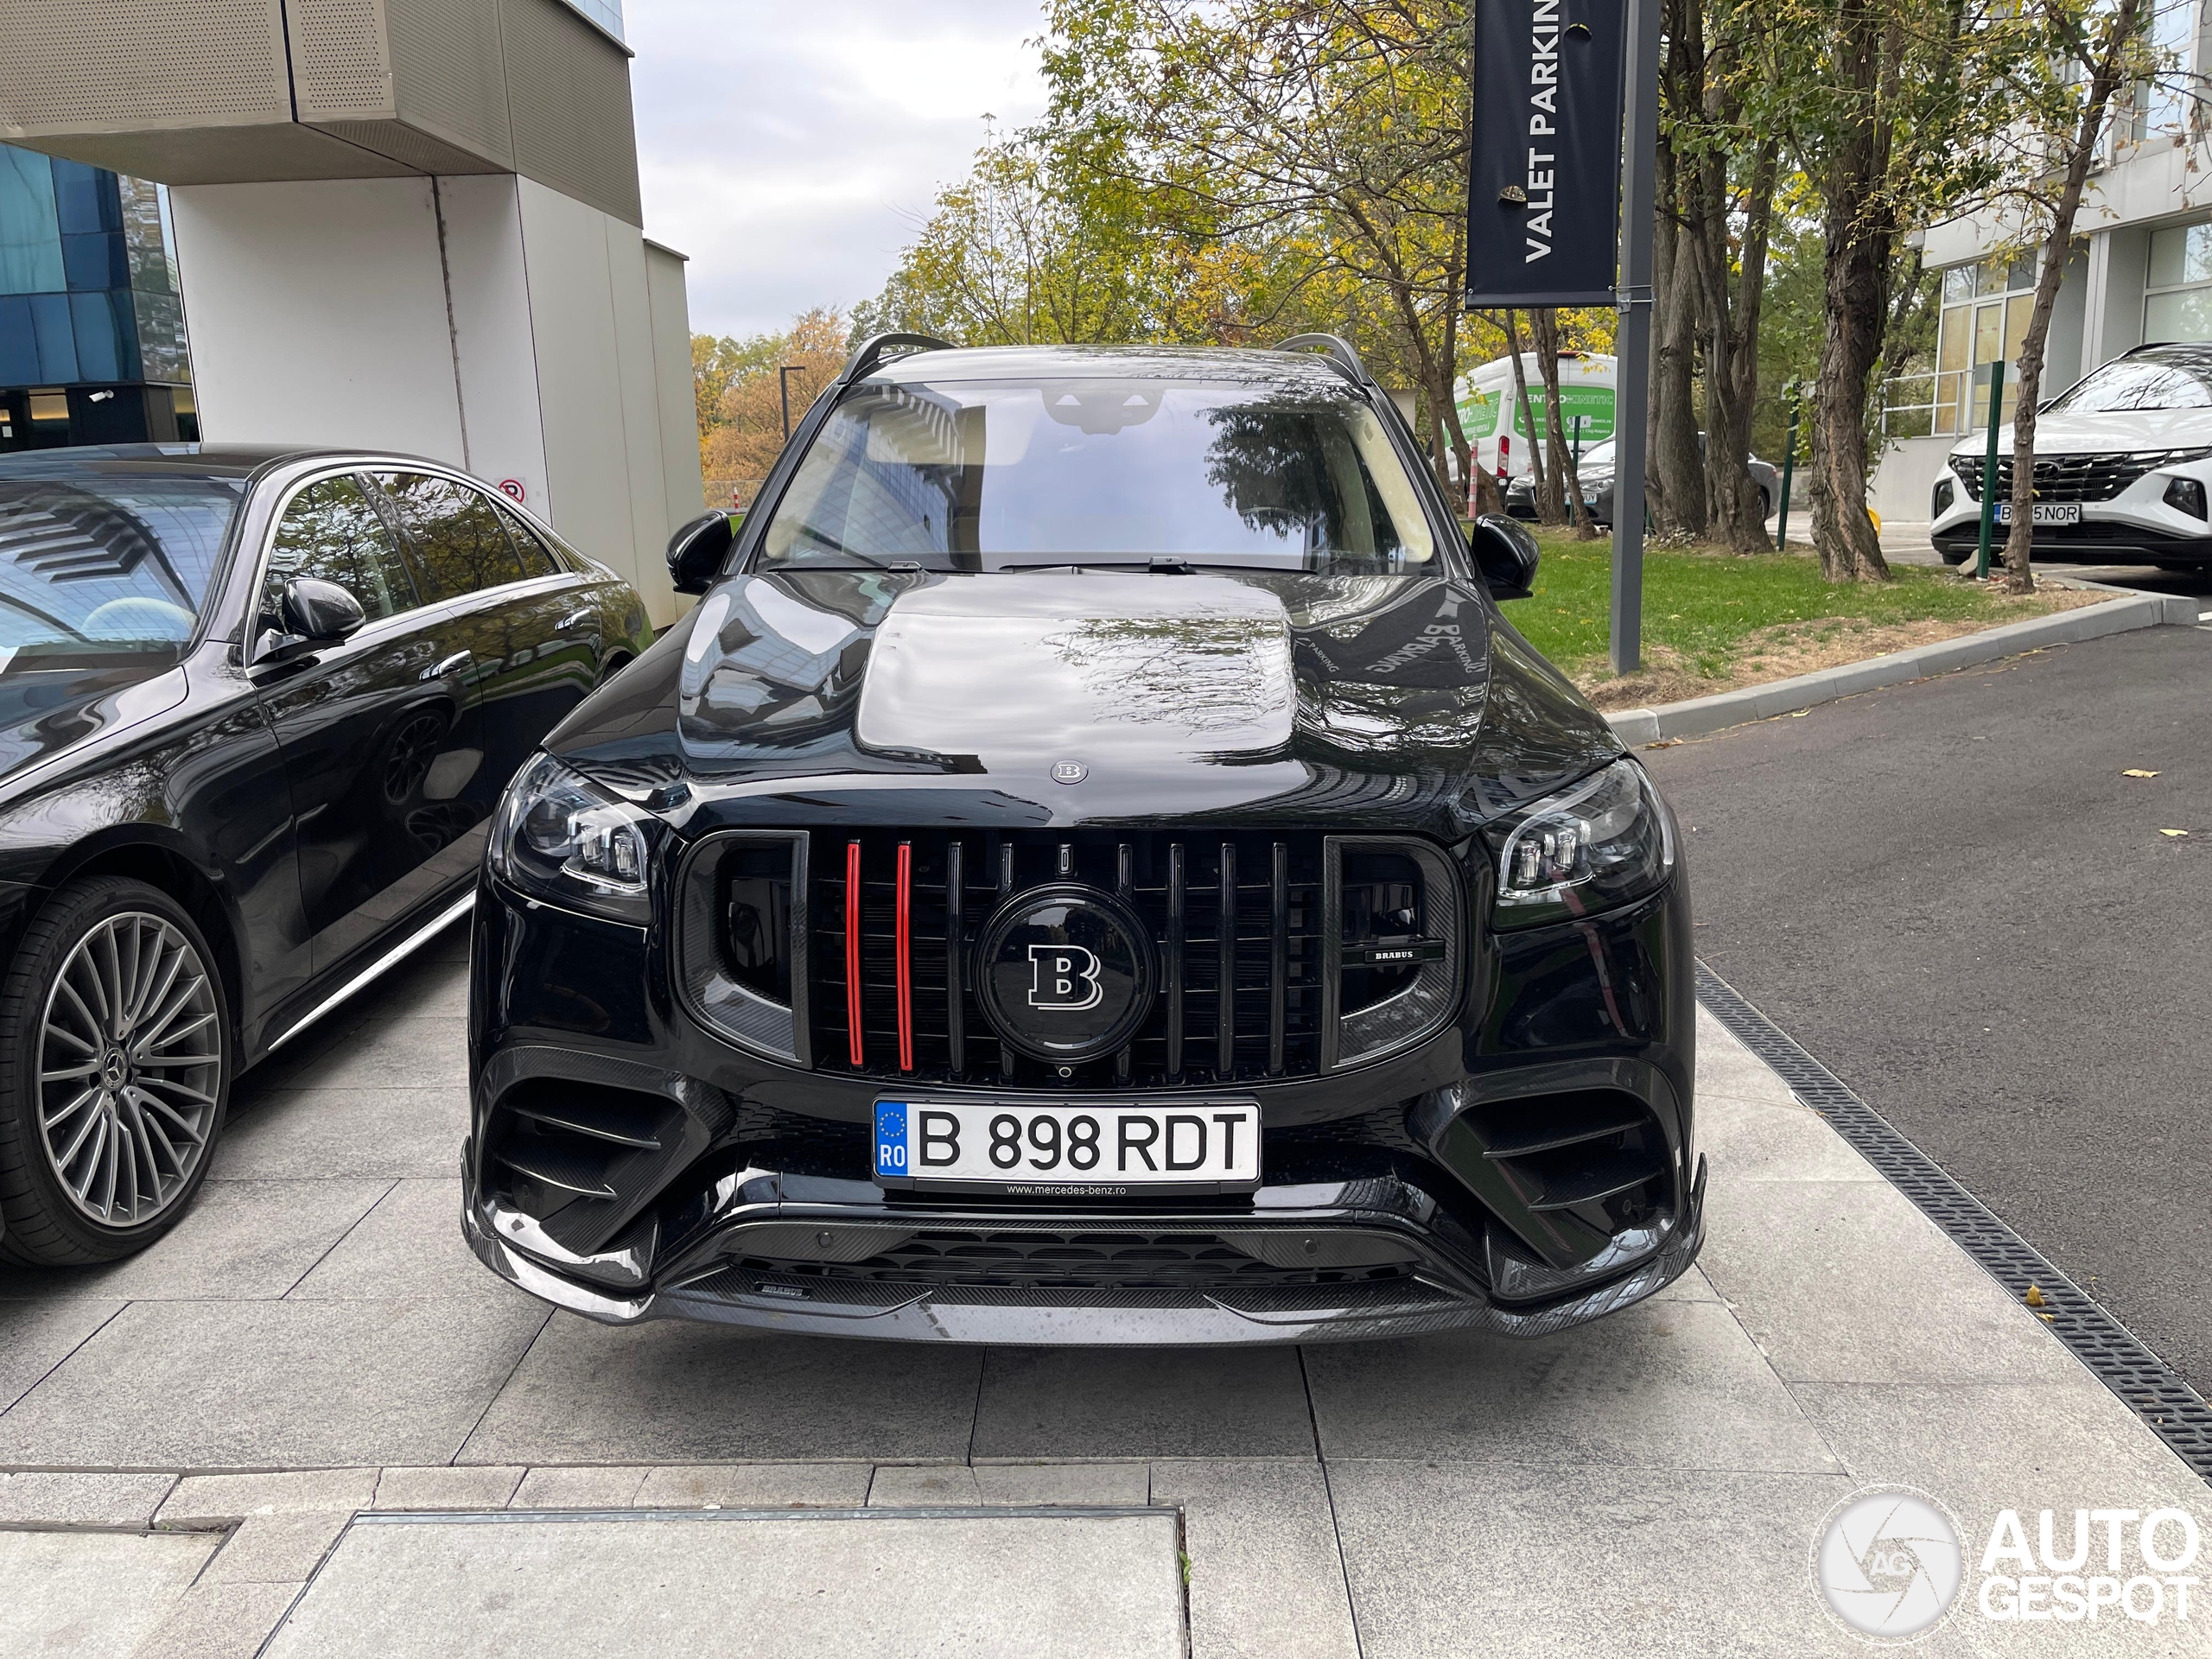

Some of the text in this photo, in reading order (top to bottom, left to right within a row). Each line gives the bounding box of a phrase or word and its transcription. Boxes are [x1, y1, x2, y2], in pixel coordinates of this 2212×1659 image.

[1526, 148, 1554, 264] VALET
[2001, 506, 2012, 520] B
[2044, 506, 2077, 520] NOR
[1058, 764, 1081, 779] B
[1375, 950, 1414, 960] BRABUS
[1028, 944, 1103, 1011] B
[918, 1110, 1247, 1172] B 898 RDT
[880, 1143, 906, 1167] RO
[1007, 1185, 1127, 1195] www.mercedes-benz.ro
